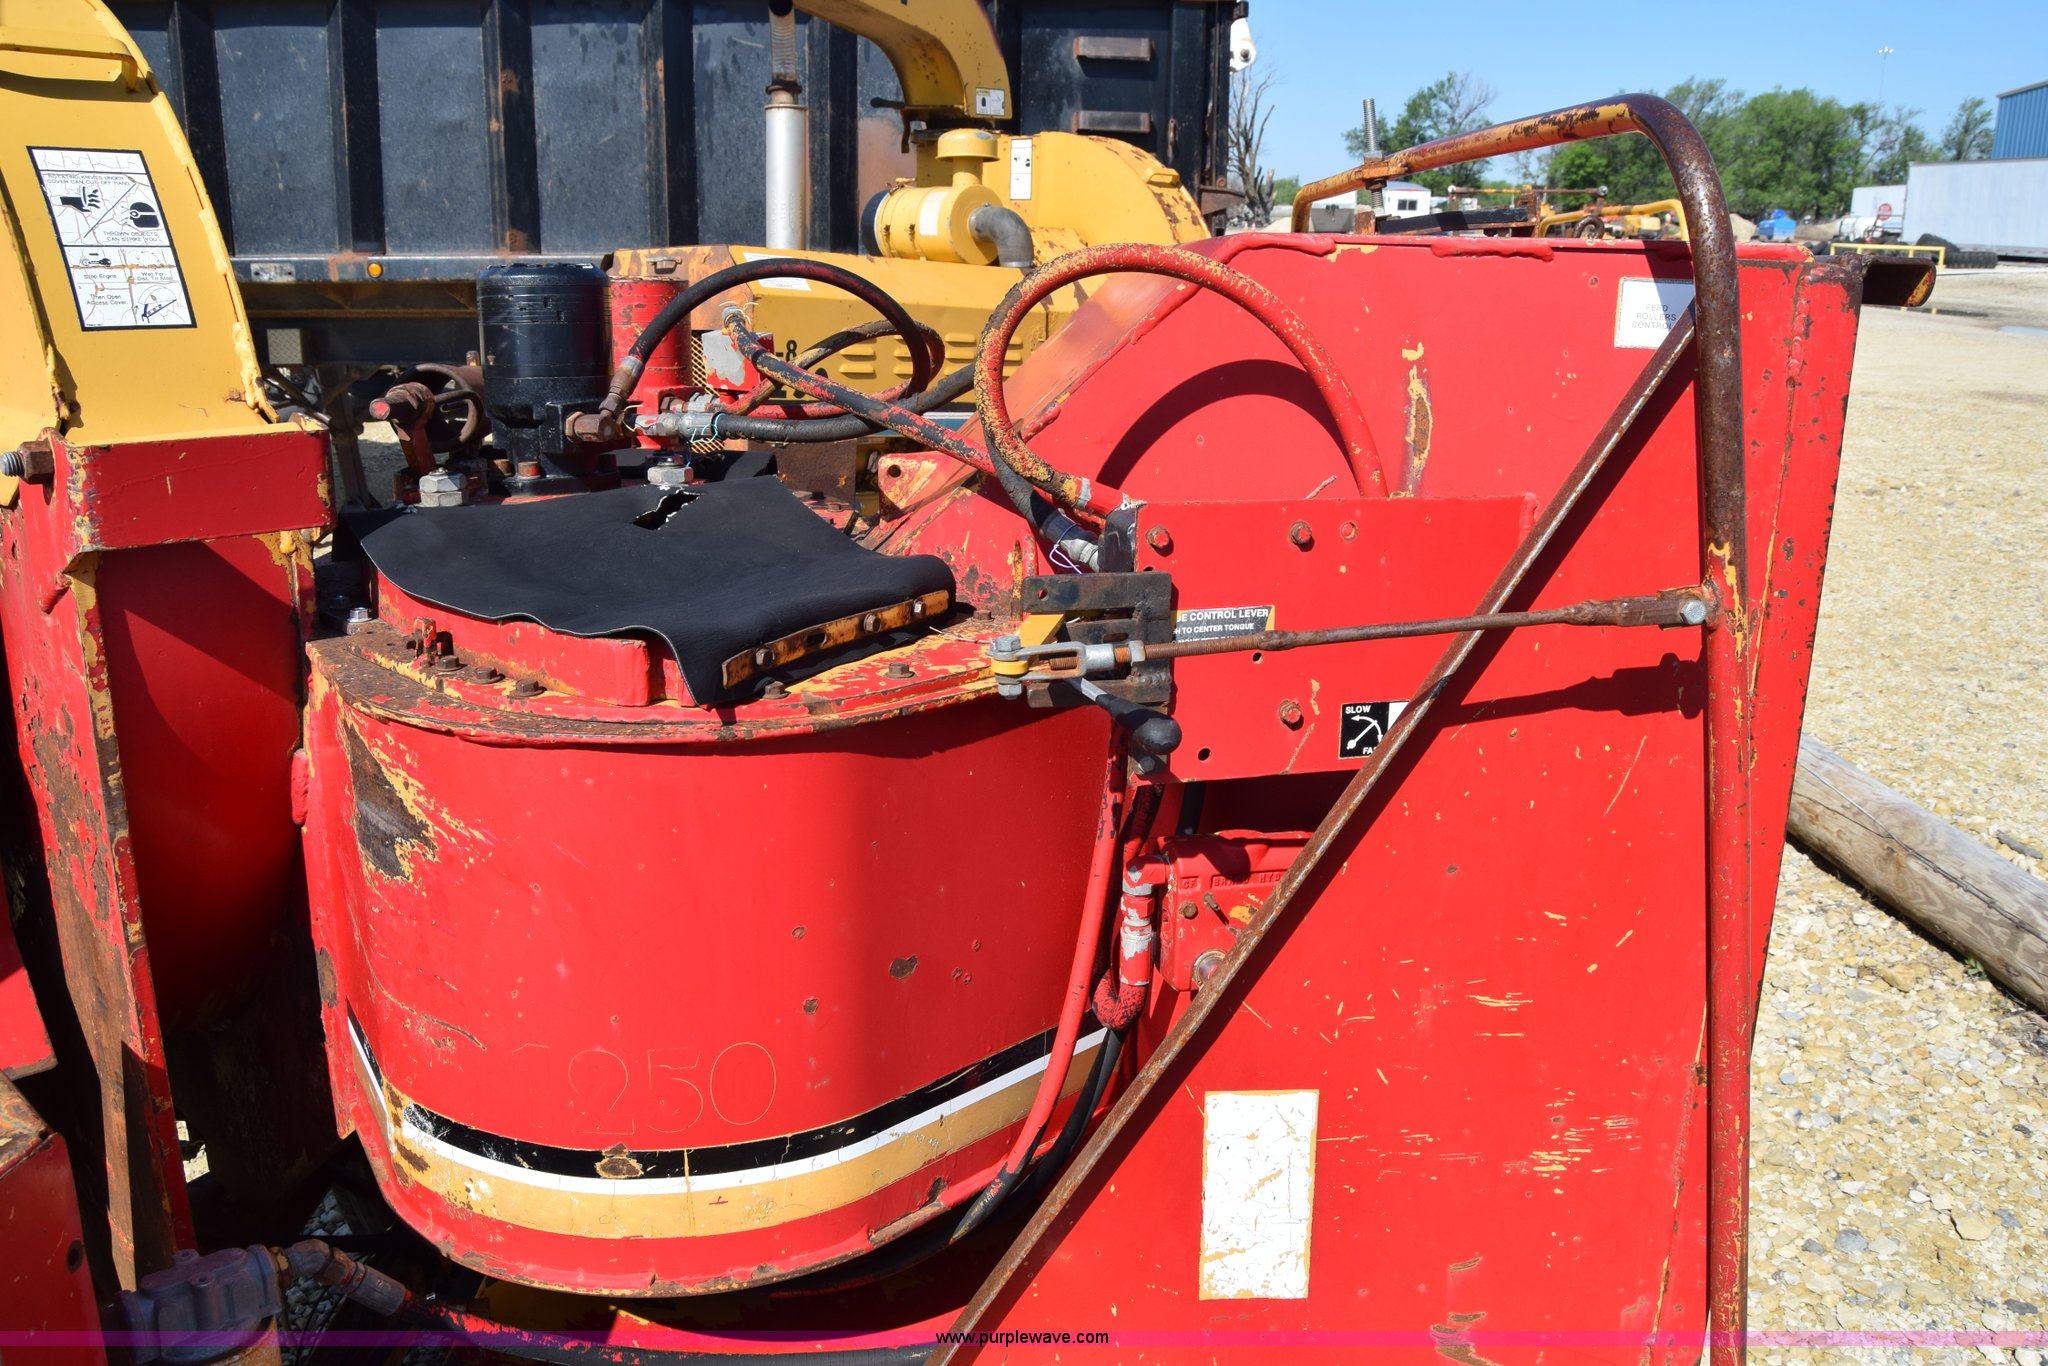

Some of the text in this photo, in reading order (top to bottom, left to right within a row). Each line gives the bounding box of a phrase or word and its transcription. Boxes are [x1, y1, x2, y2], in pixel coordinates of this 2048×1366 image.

[1645, 303, 1669, 312] FEED
[1636, 312, 1677, 321] ROLLERS
[1189, 609, 1237, 621] CONTROL
[1238, 608, 1269, 618] LEVER
[1181, 626, 1193, 634] TO
[1193, 624, 1223, 633] CENTER
[1224, 622, 1255, 631] TONGUE
[1345, 704, 1371, 714] SLOW
